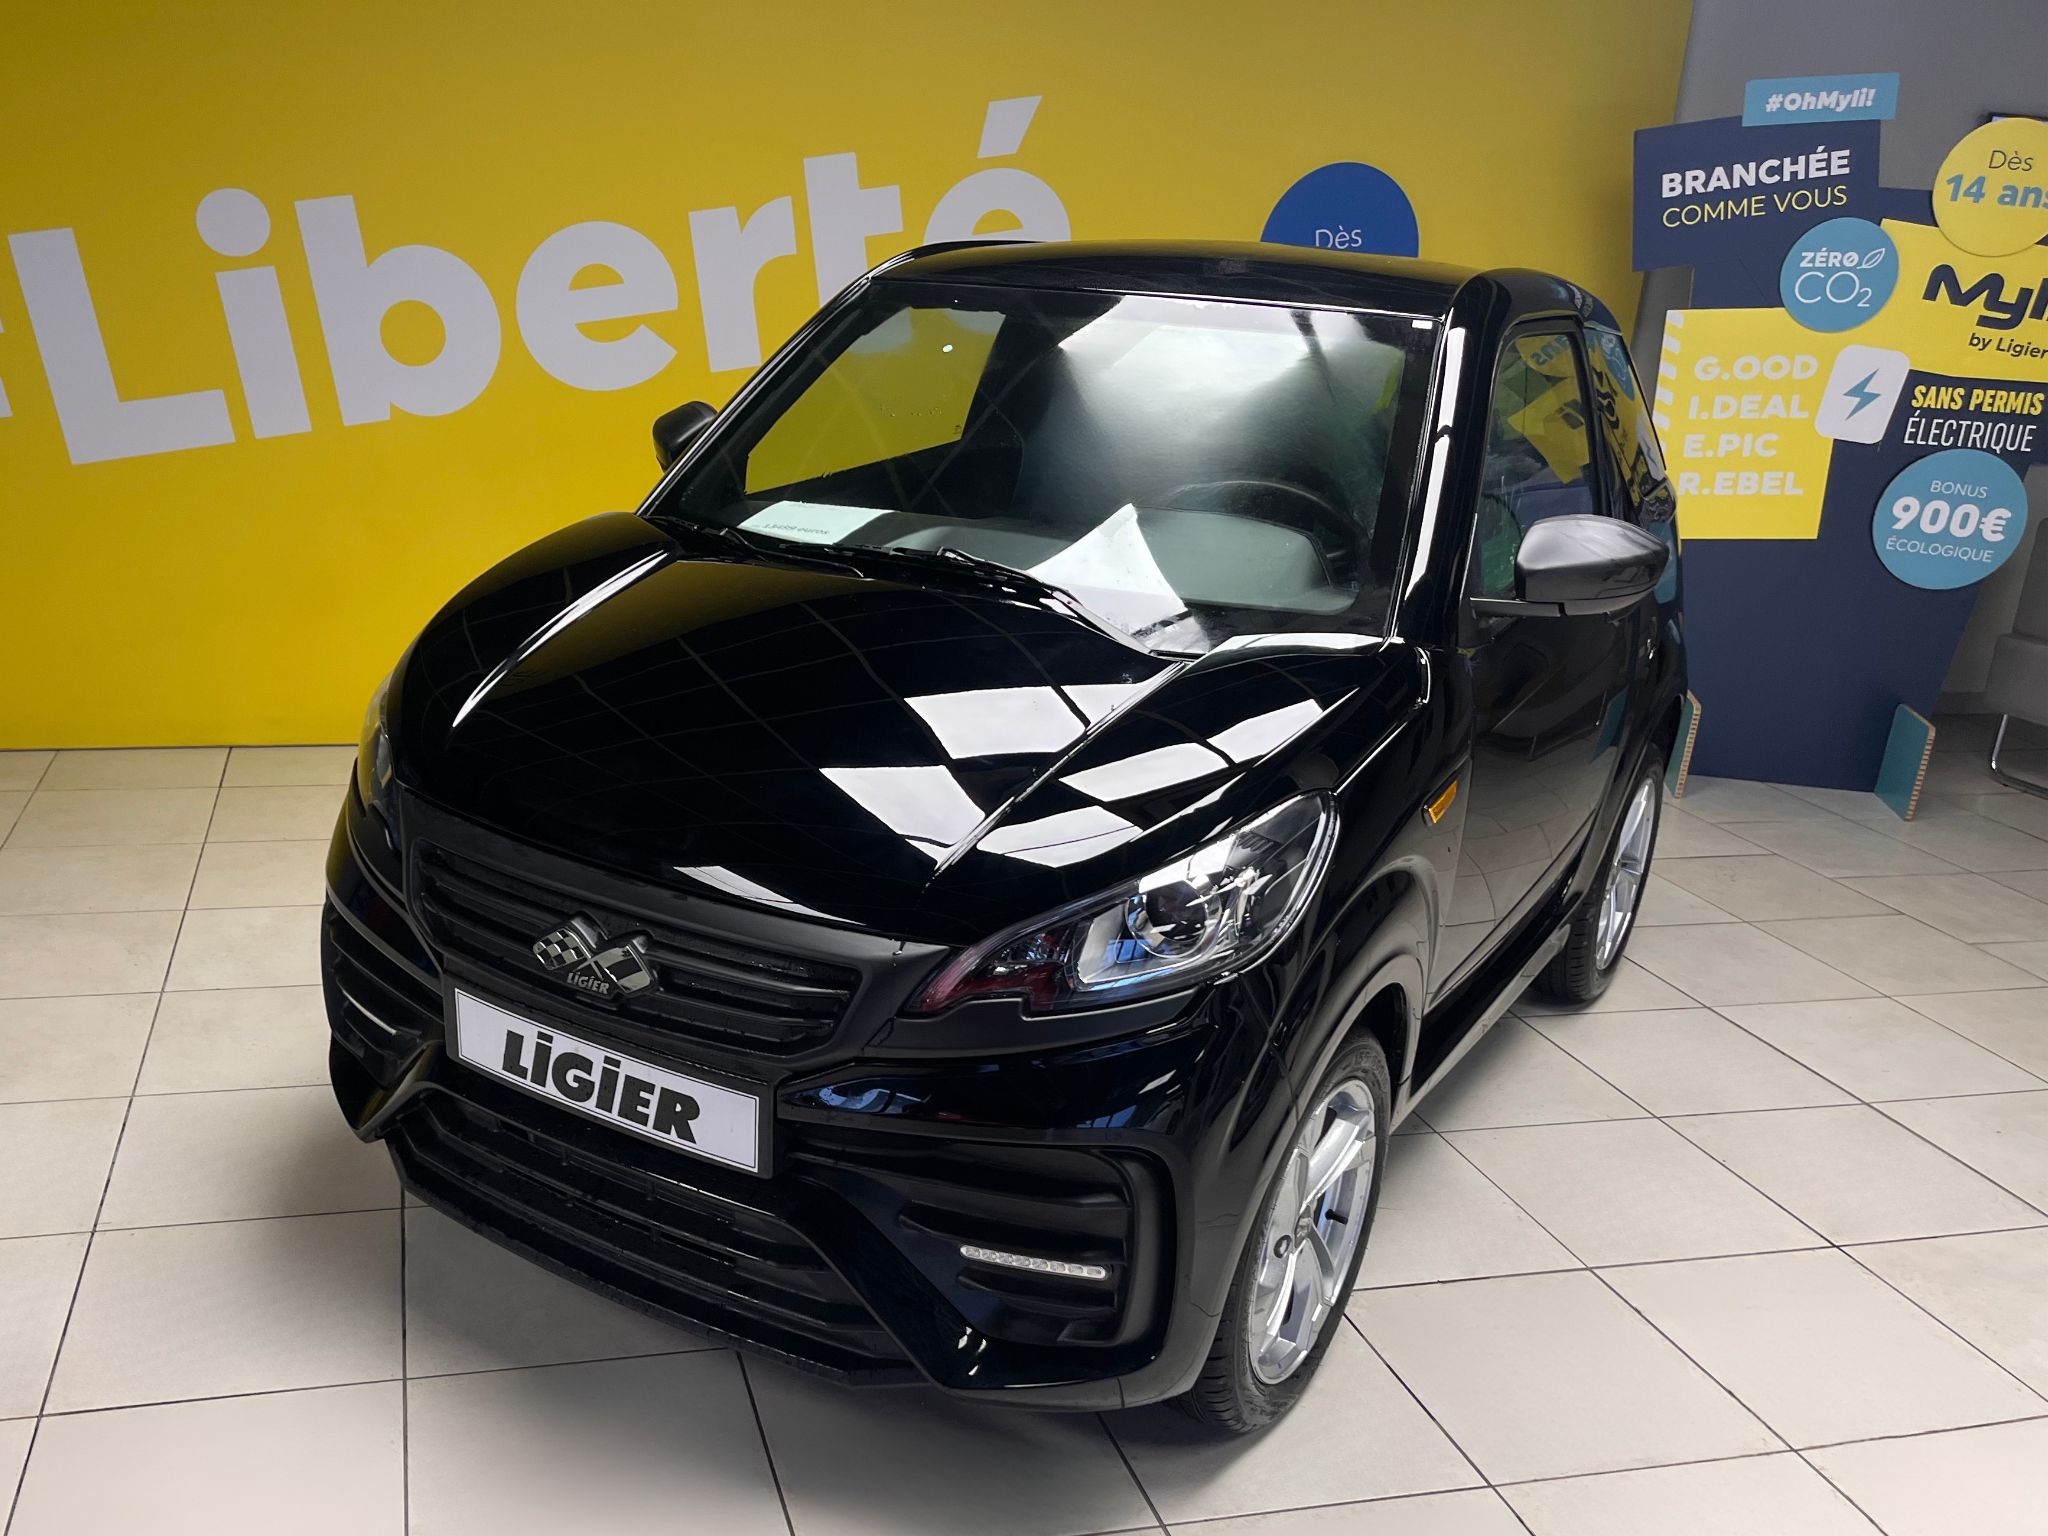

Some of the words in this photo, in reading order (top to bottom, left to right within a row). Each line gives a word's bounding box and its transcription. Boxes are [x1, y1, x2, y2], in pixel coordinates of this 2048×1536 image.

[1765, 88, 1877, 113] #OhMyli!
[1661, 145, 1851, 198] BRANCHÉE
[1988, 150, 2034, 171] Dès
[1946, 173, 1986, 203] 14
[1662, 195, 1766, 228] COMME
[1774, 186, 1848, 212] VOUS
[1315, 225, 1362, 249] Dès
[1800, 247, 1859, 268] ZÉRO
[0, 95, 1071, 465] Liberté
[1922, 263, 2048, 331] Myl
[1968, 332, 1993, 351] by
[1995, 337, 2048, 359] Ligier
[1694, 355, 1818, 381] G.OOD
[1688, 394, 1809, 419] I.DEAL
[1911, 385, 1963, 411] SANS
[1969, 388, 2045, 416] PERMIS
[1683, 433, 1779, 458] E.PIC
[1903, 412, 2037, 453] ÉLECTRIQUE
[1678, 471, 1804, 496] R.EBEL
[1930, 480, 1989, 499] BONUS
[1891, 495, 2012, 542] 900€
[1886, 535, 1995, 563] ÉCOLOGIQUE
